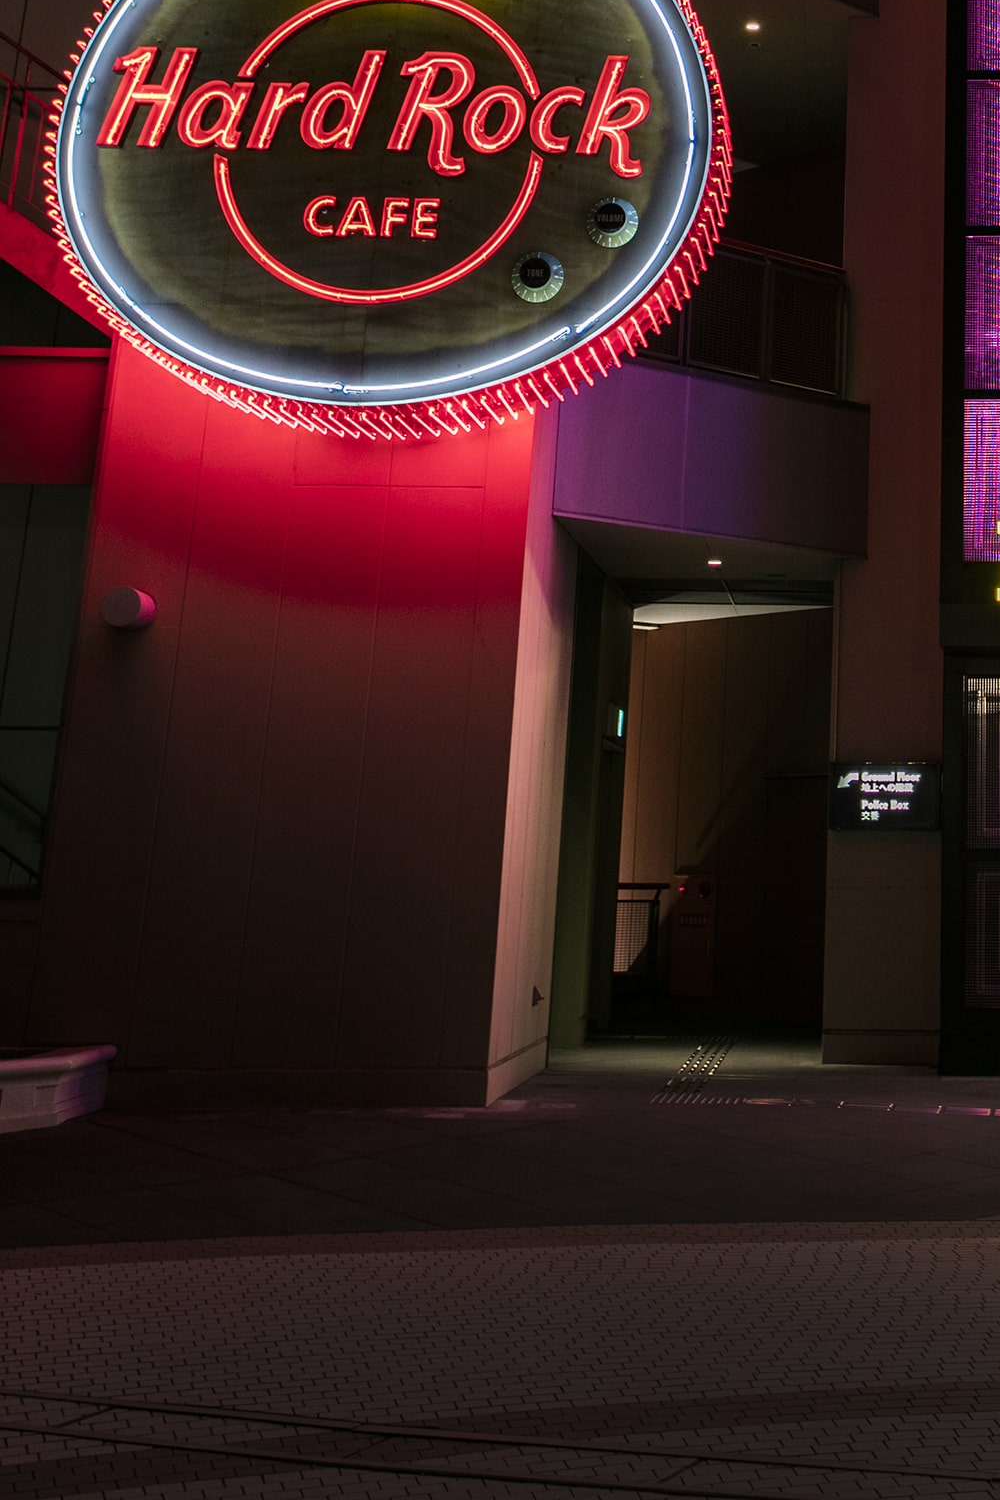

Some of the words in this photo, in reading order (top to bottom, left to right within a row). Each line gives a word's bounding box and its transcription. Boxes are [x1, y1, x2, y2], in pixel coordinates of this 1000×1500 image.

[96, 46, 387, 151] Hard
[388, 50, 652, 178] Rock
[303, 195, 441, 240] CAFE
[527, 268, 544, 277] TONE
[861, 771, 895, 782] Ground
[896, 771, 921, 782] Floor
[861, 800, 888, 810] Police
[890, 800, 909, 810] Box
